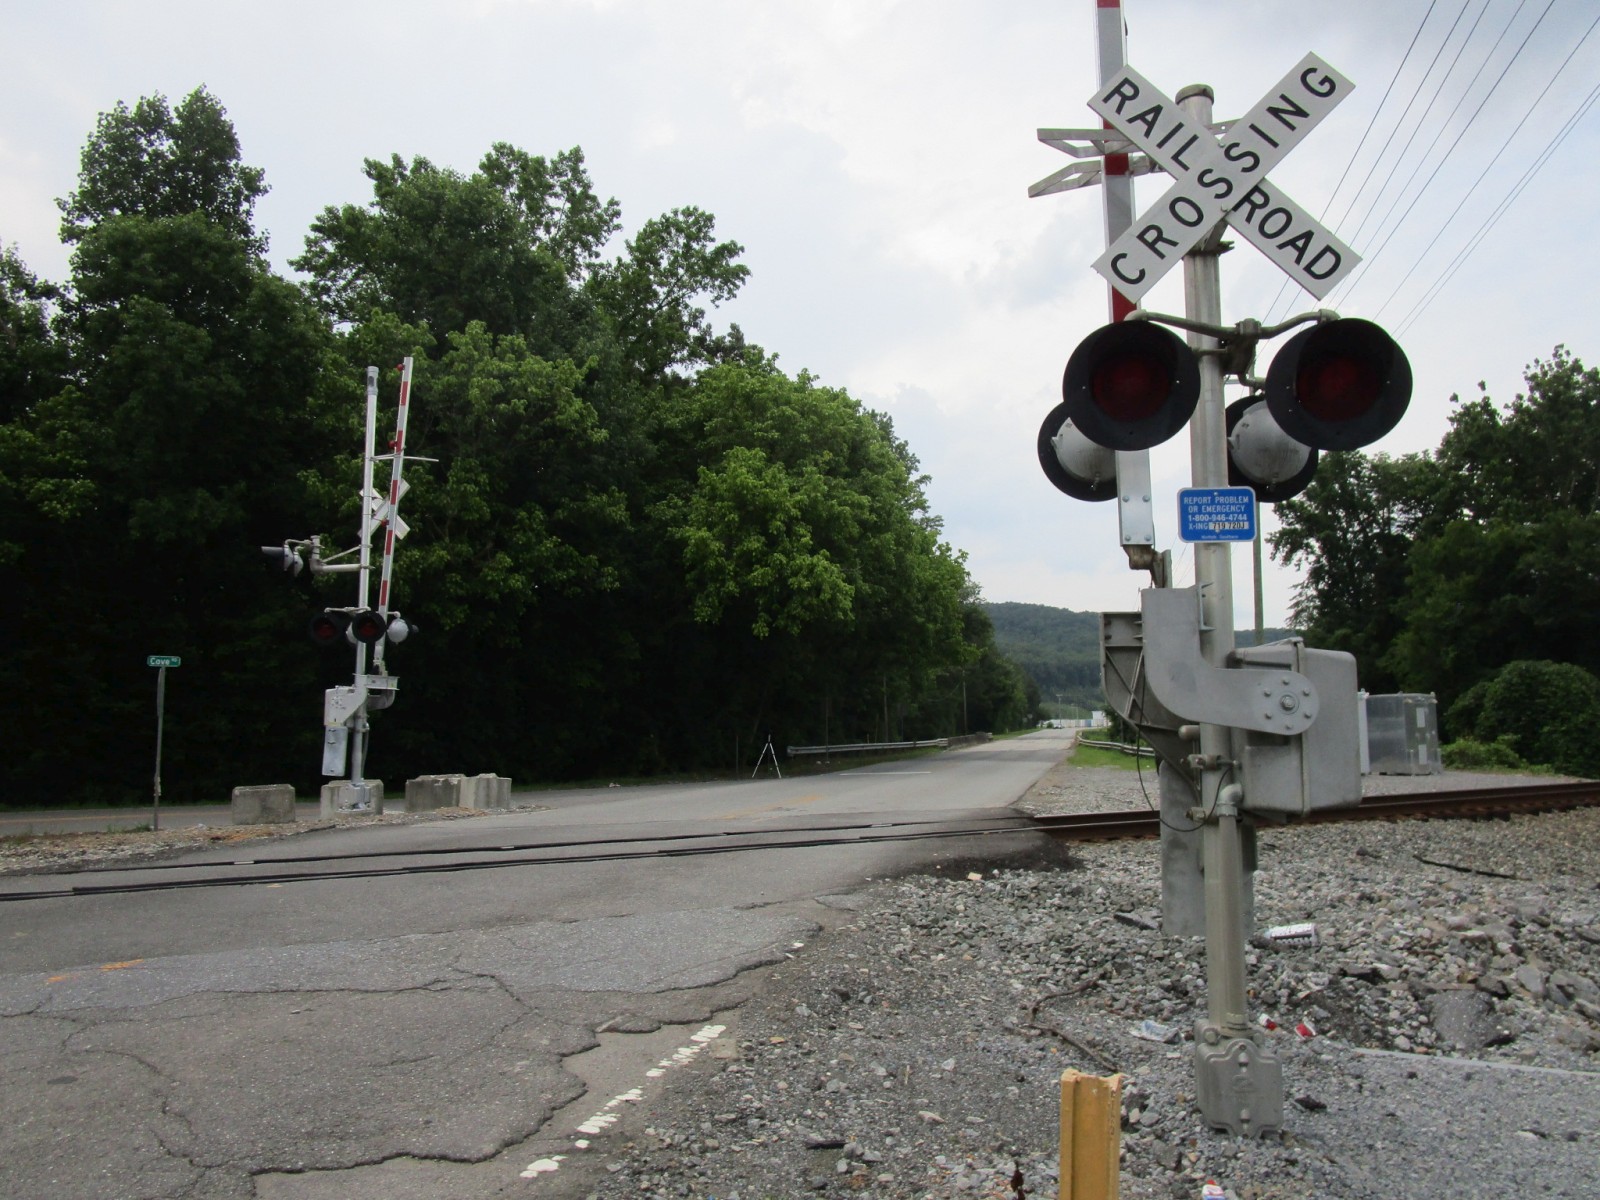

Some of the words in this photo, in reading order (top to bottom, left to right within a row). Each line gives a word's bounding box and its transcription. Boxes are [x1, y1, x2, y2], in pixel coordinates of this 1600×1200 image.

[1102, 77, 1199, 172] RAIL
[1231, 185, 1341, 280] ROAD
[1110, 67, 1337, 285] CROSSING
[1184, 496, 1211, 504] REPORT
[1215, 496, 1249, 504] PROBLEM
[1188, 505, 1198, 513] OR
[1202, 505, 1246, 513] EMERGENCY
[1188, 514, 1247, 522] 1-800-946-4744
[1188, 522, 1208, 530] X-ING
[150, 657, 170, 665] Cove
